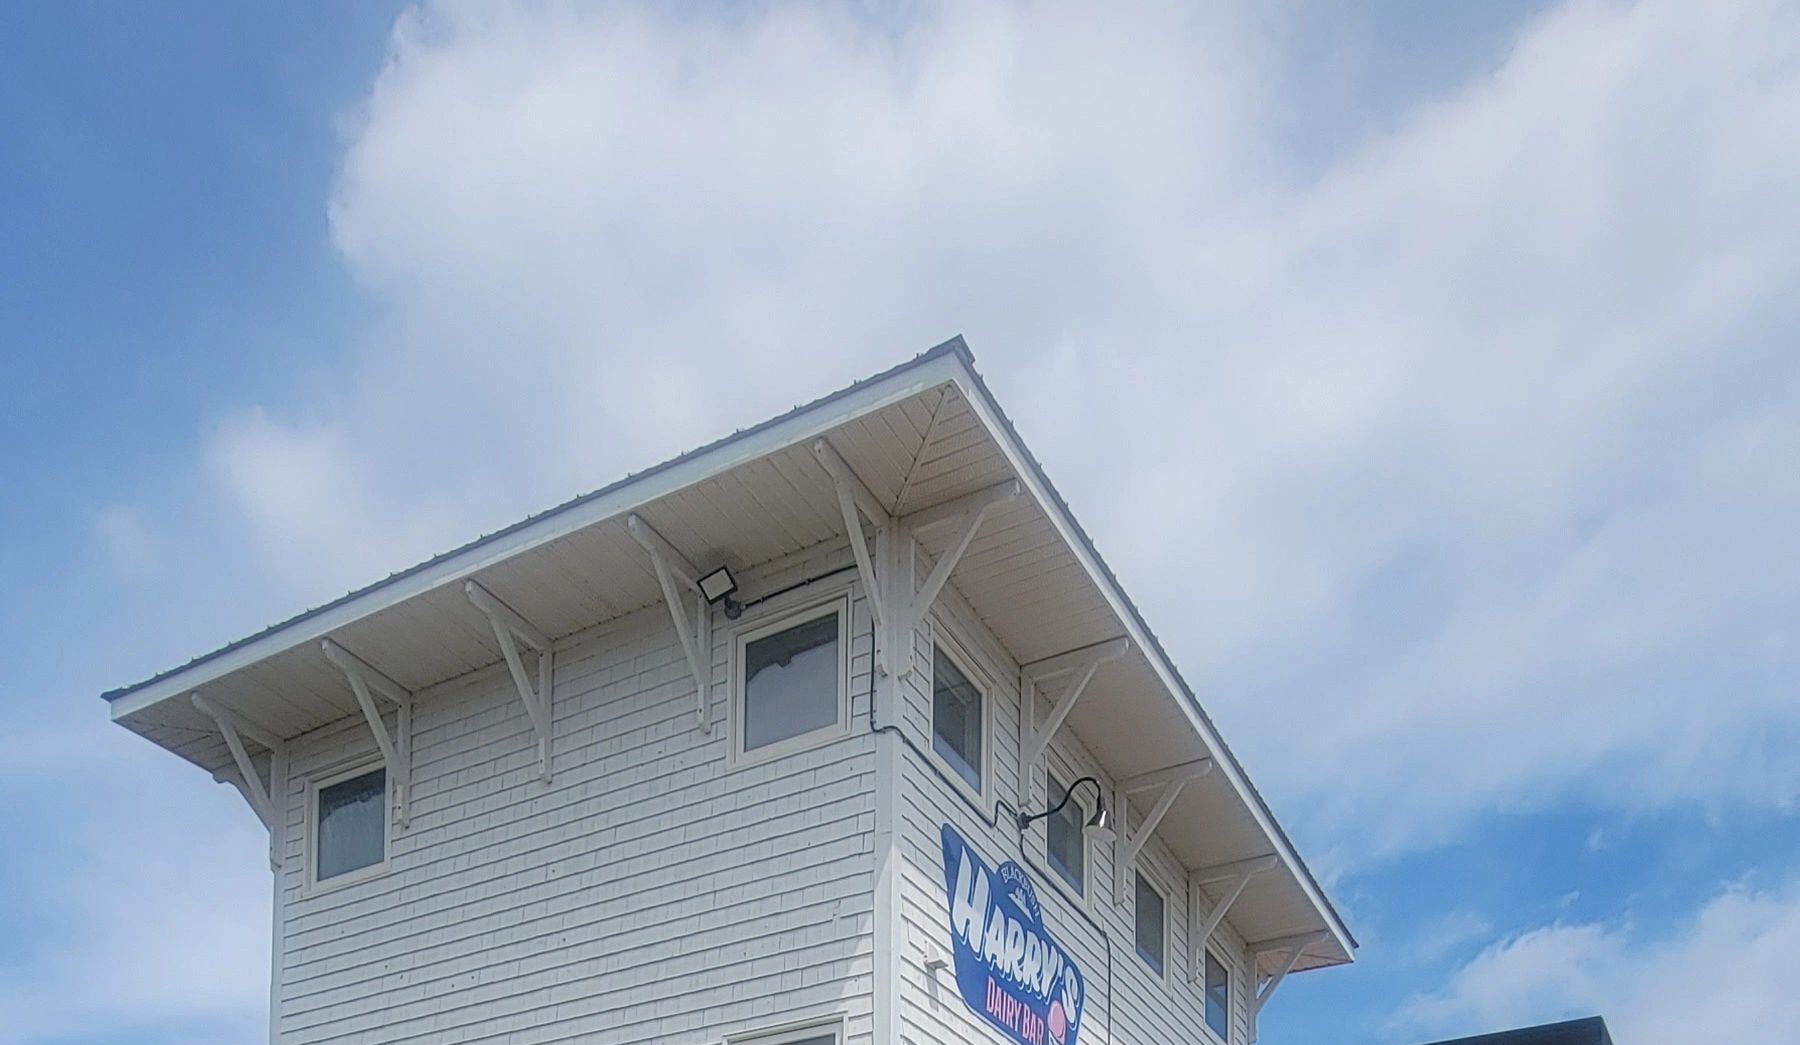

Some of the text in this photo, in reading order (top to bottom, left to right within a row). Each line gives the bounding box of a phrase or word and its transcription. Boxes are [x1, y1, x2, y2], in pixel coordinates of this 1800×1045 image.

[1001, 866, 1040, 917] BLACKBUSH
[952, 845, 1080, 1030] HARRY'S
[985, 976, 1020, 1033] DAIRY
